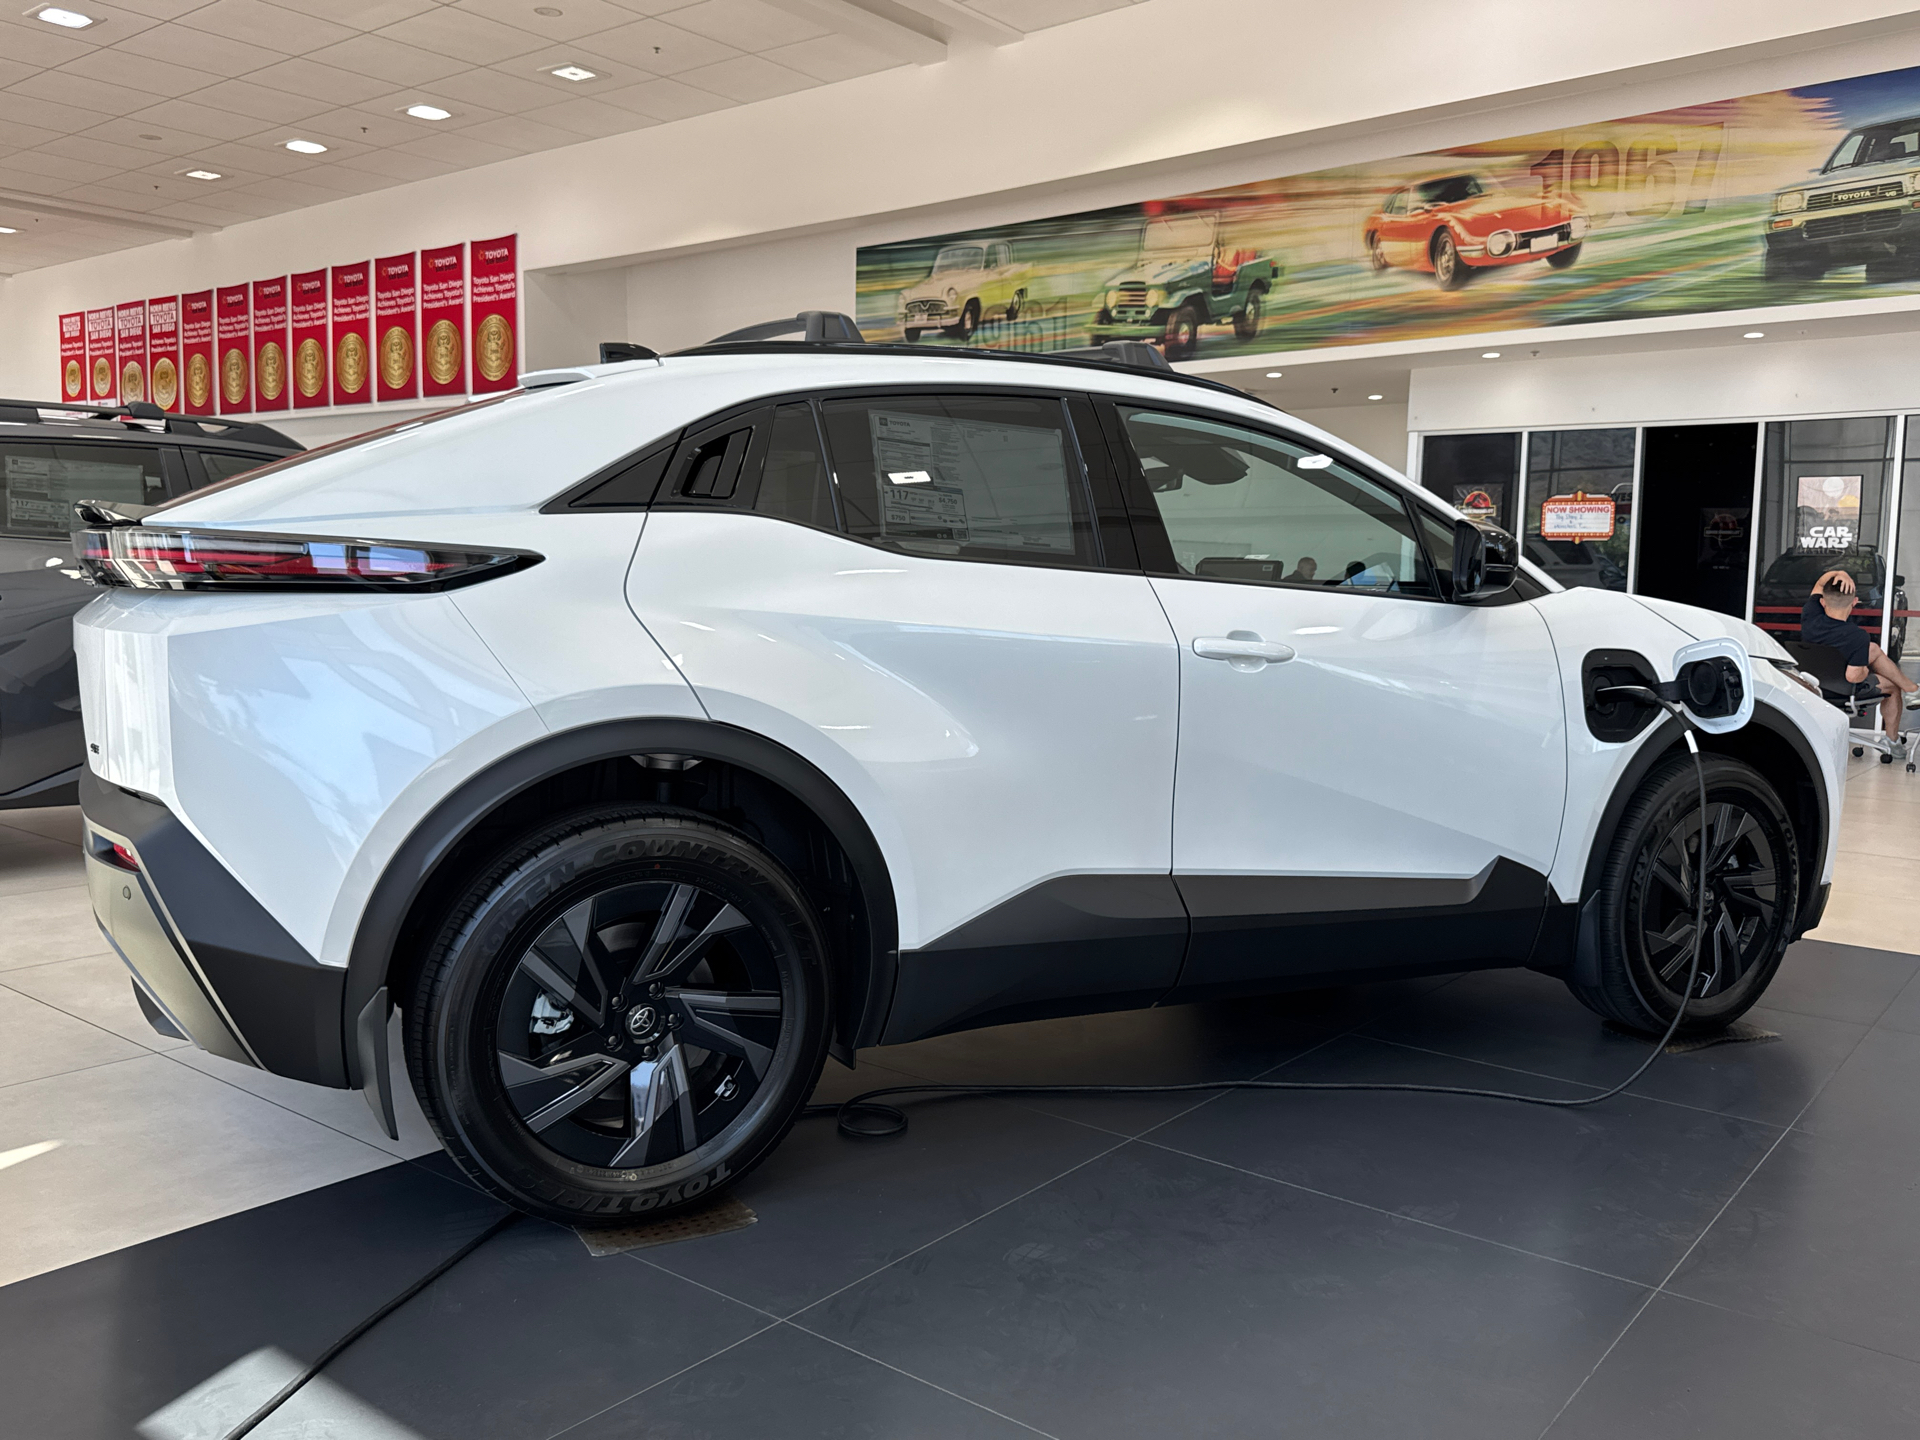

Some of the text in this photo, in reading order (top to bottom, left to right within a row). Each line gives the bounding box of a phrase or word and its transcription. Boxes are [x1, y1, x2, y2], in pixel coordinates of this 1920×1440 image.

[1530, 121, 1724, 222] 1967
[1838, 191, 1870, 201] TOYOTA
[485, 248, 508, 259] TOYOTA
[435, 256, 457, 267] TOYOTA
[388, 265, 409, 274] TOYOTA
[344, 273, 363, 283] TOYOTA
[473, 272, 515, 285] Toyota San Diego
[263, 285, 280, 294] TOYOTA
[302, 281, 320, 290] TOYOTA
[423, 284, 438, 292] Toyota
[449, 280, 463, 289] Diego
[495, 282, 515, 291] Toyota's
[424, 292, 443, 300] Achieves
[473, 291, 515, 302] President's Award
[423, 298, 463, 309] President's Award
[890, 490, 909, 500] 117
[1810, 526, 1852, 537] CAR
[1800, 537, 1852, 548] WARS
[482, 861, 576, 954] OPEN
[593, 839, 768, 886] COUNTRY
[630, 1161, 731, 1212] TOYO
